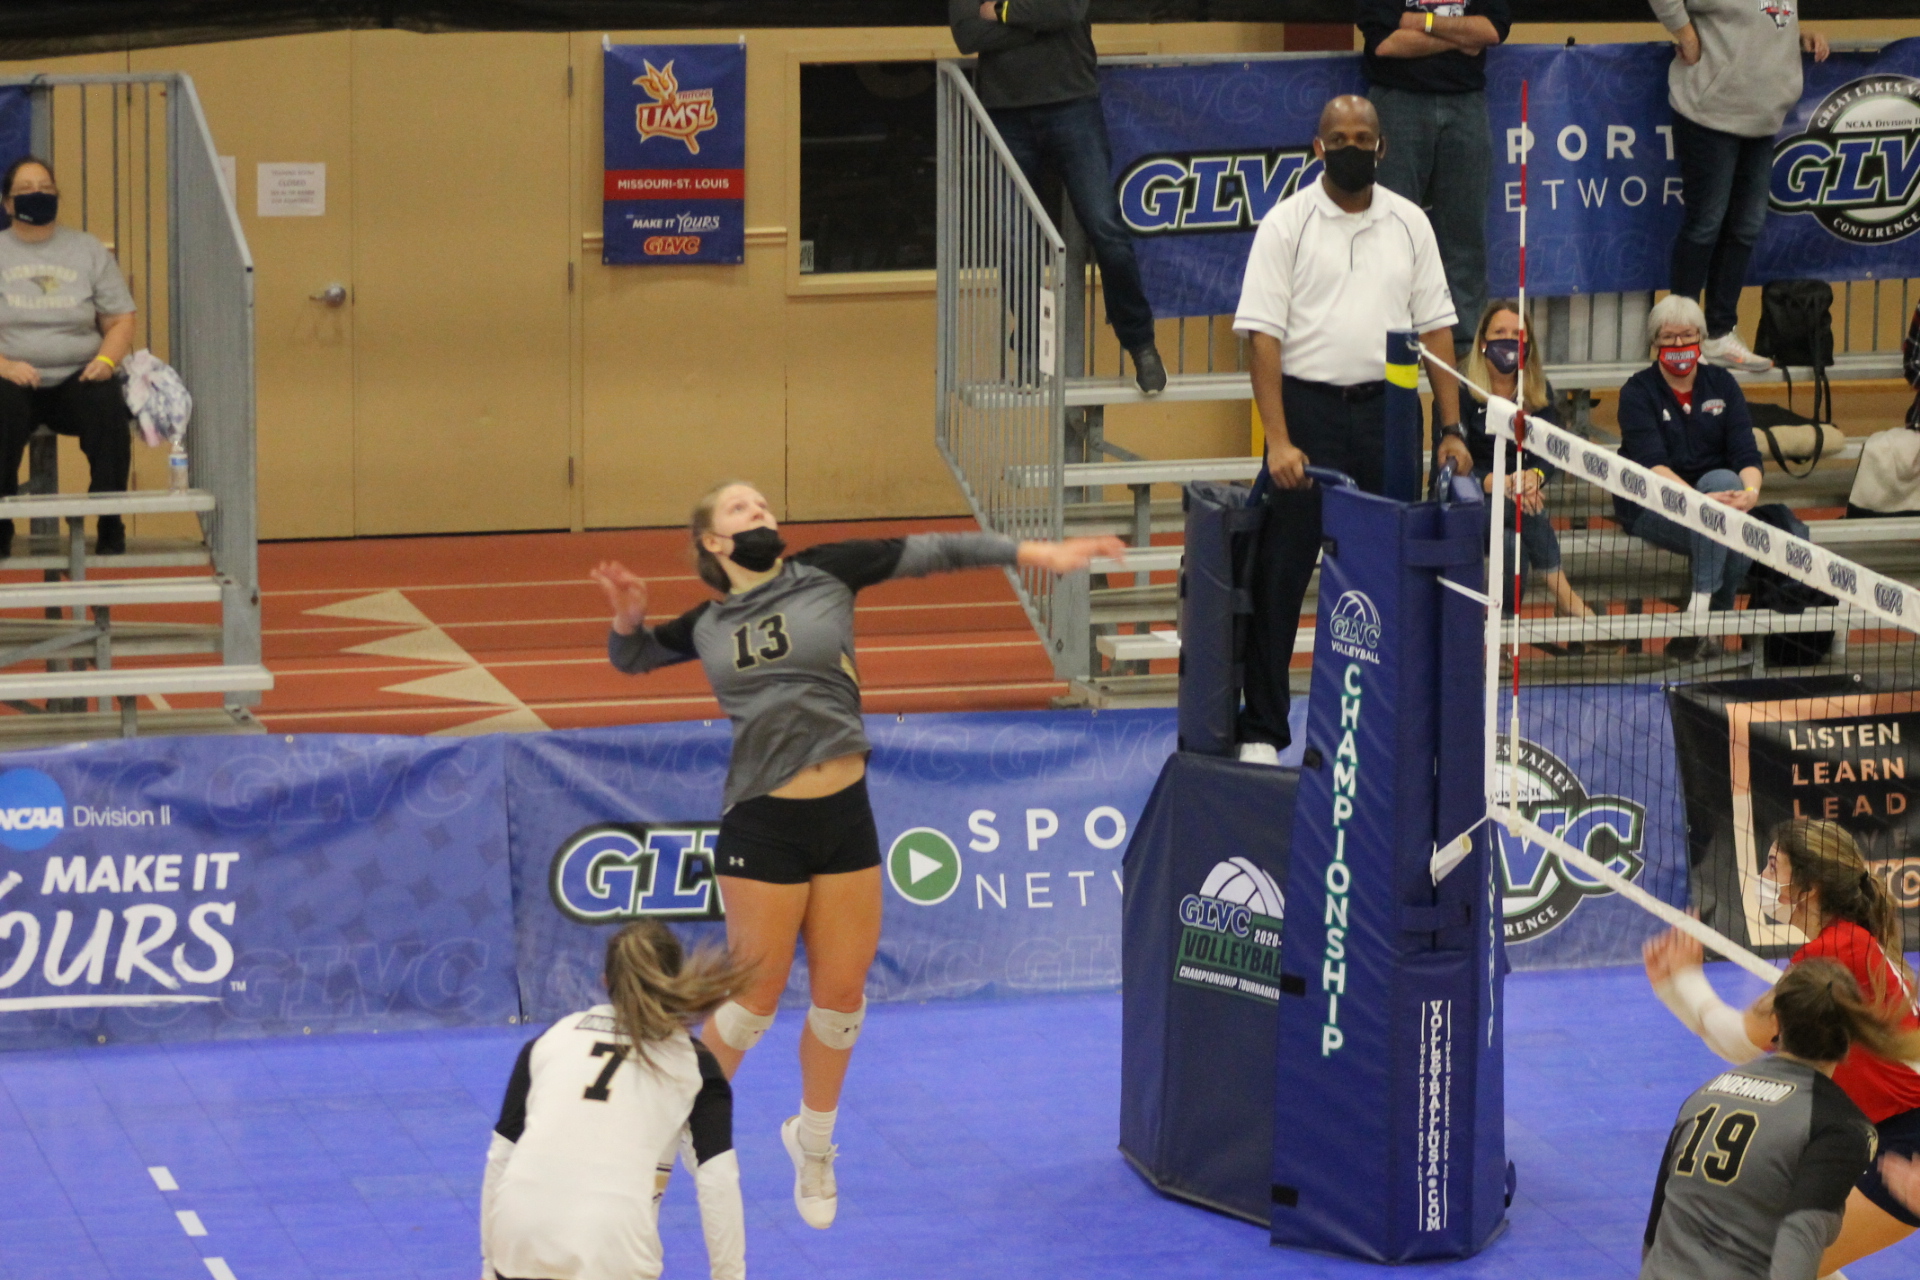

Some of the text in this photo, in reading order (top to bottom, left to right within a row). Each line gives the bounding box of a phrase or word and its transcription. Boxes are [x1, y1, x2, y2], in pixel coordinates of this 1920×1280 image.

[641, 101, 715, 133] UMSL
[1818, 92, 1851, 128] GREAT
[1855, 82, 1901, 96] LAKES
[1845, 120, 1872, 128] NCAA
[1507, 125, 1675, 164] PORT
[617, 178, 730, 190] MISSOURI-ST. LOUIS
[1769, 136, 1920, 206] GLV
[1505, 176, 1685, 212] ETWOR
[632, 211, 720, 233] MAKE IT YOURS
[1833, 211, 1920, 239] CONFERENCE
[643, 236, 702, 255] GLVC
[733, 613, 792, 671] 13
[1330, 614, 1381, 649] GLVC
[1331, 640, 1381, 665] VOLLEYBALL
[1788, 722, 1900, 750] LISTEN
[1518, 745, 1573, 793] VALLEY
[1792, 757, 1905, 786] LEARN
[0, 805, 171, 831] NCAA Division II
[1793, 793, 1907, 820] LEAD
[968, 806, 1127, 853] SPO
[1497, 805, 1637, 889] VC
[41, 852, 240, 895] MAKE IT
[558, 830, 726, 918] GL
[1322, 663, 1362, 1057] CHAMPIONSHIP
[0, 873, 237, 990] OURS
[1179, 894, 1252, 938] GLVC
[1504, 905, 1558, 936] RENCE
[1184, 931, 1282, 979] VOLLEYBAL
[1179, 965, 1281, 1000] CHAMPIONSHIP TOURNAMEN
[581, 1040, 634, 1103] 7
[1706, 1073, 1794, 1102] LINDENWOOD
[1675, 1103, 1760, 1187] 19
